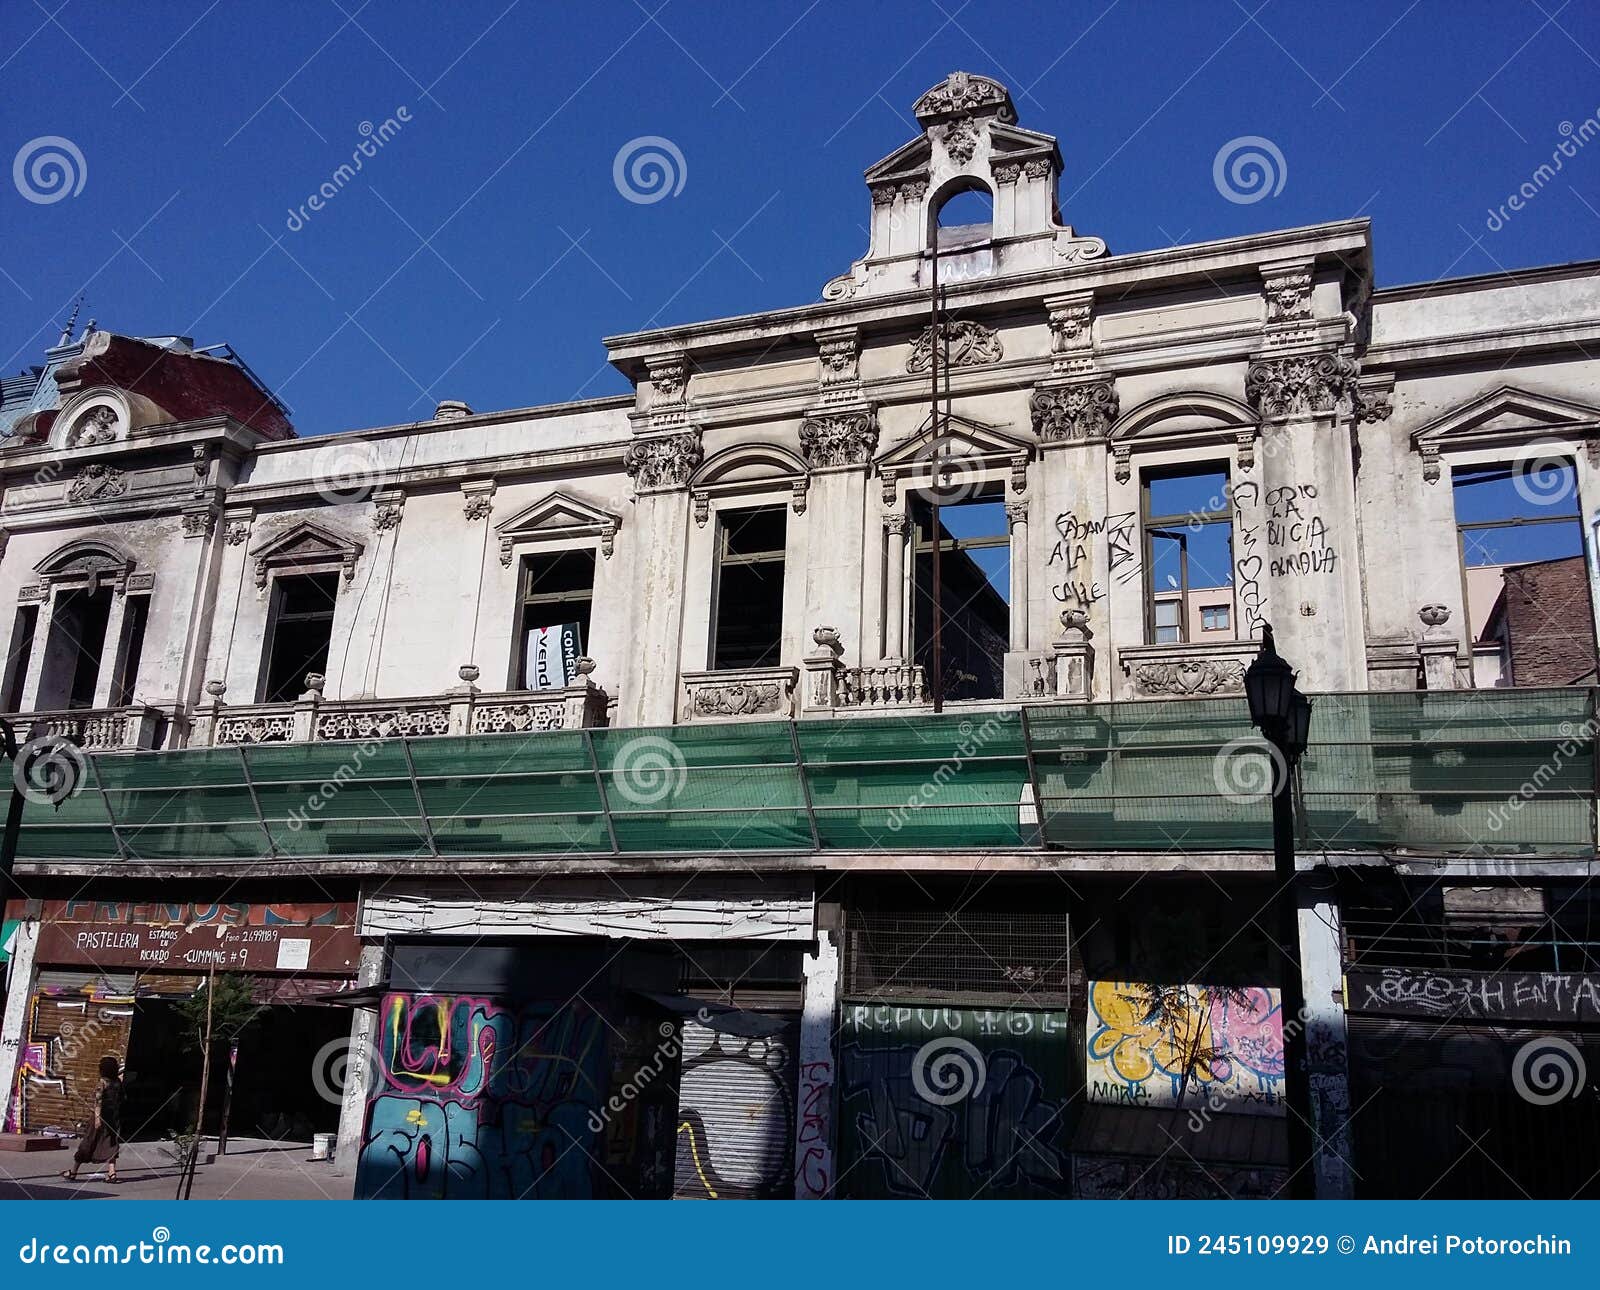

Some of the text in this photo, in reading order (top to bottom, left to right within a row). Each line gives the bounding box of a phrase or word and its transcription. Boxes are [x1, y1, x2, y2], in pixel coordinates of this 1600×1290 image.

[538, 635, 552, 690] vend
[76, 931, 140, 949] PASTELERIA
[149, 930, 179, 940] ESTAMOS
[140, 949, 170, 961] RICARDO
